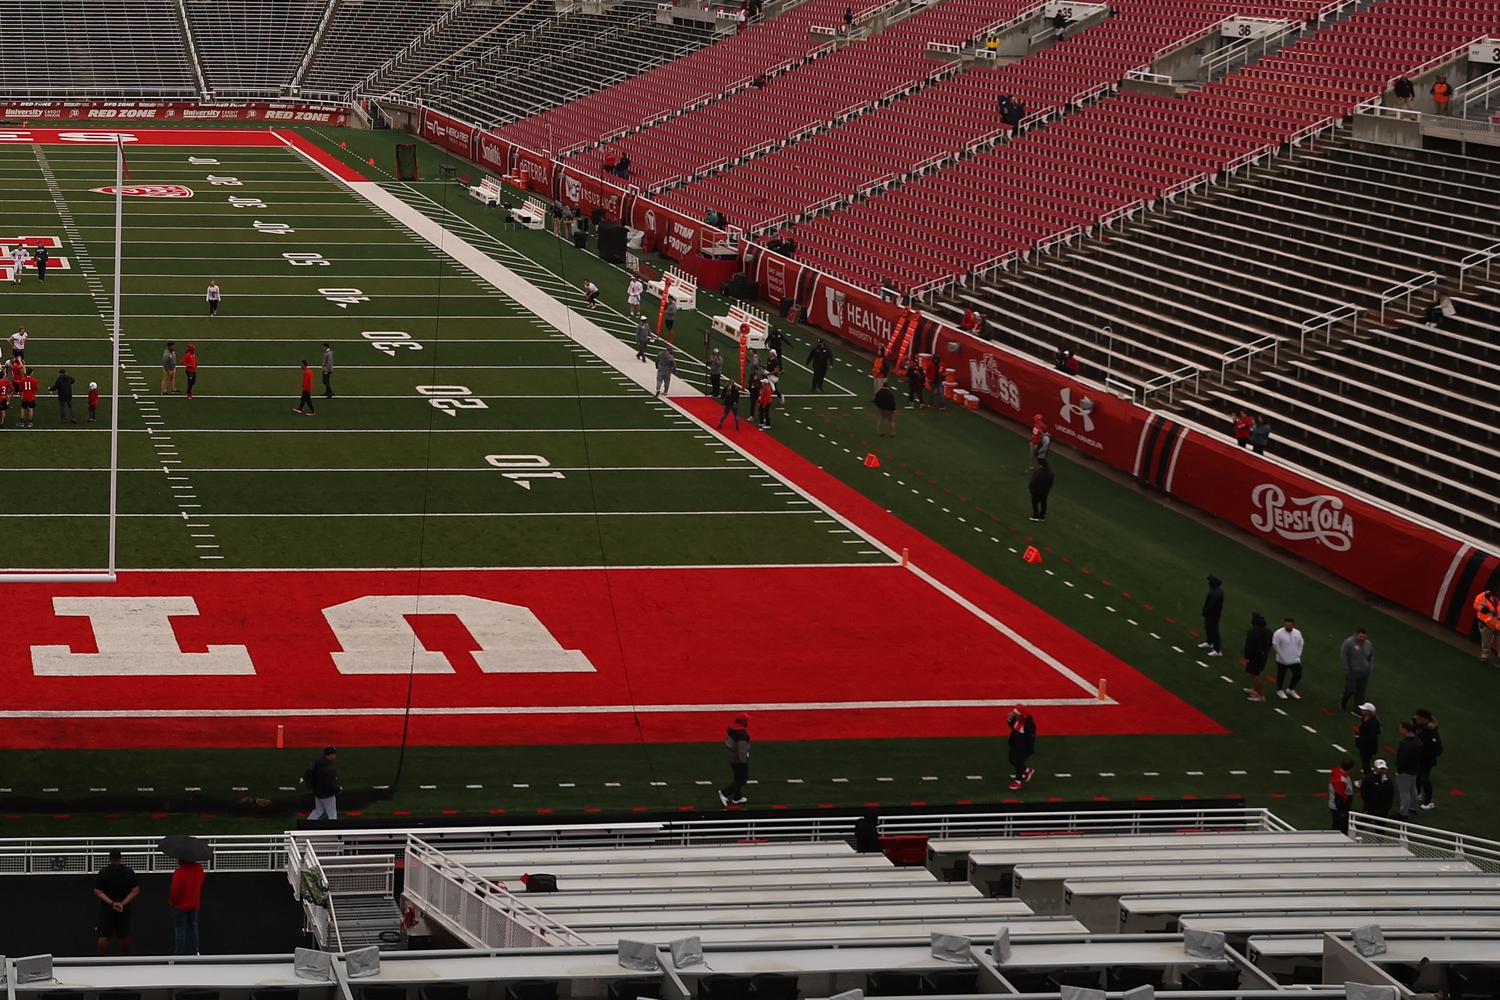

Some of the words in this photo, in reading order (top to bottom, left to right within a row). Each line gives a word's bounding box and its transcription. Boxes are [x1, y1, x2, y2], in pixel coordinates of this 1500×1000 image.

[1239, 25, 1251, 37] 36
[5, 109, 43, 117] University
[88, 109, 118, 118] RED
[117, 109, 157, 118] ZONE
[183, 109, 221, 118] University
[265, 111, 294, 120] RED
[296, 111, 330, 122] ZONE
[581, 186, 617, 215] INSURANCE
[674, 222, 695, 240] UTAH
[282, 252, 331, 266] 50
[317, 288, 370, 303] 40
[847, 302, 891, 341] HEALTH
[361, 331, 423, 350] 30
[1, 386, 6, 395] 3
[24, 381, 32, 390] 11
[969, 359, 1021, 411] MUSS
[415, 385, 489, 409] 20
[1055, 423, 1076, 439] UNDER
[1077, 433, 1104, 450] ARMOUR
[484, 455, 566, 479] 10
[1251, 483, 1354, 552] PEPSI-COLA
[1026, 548, 1034, 560] G
